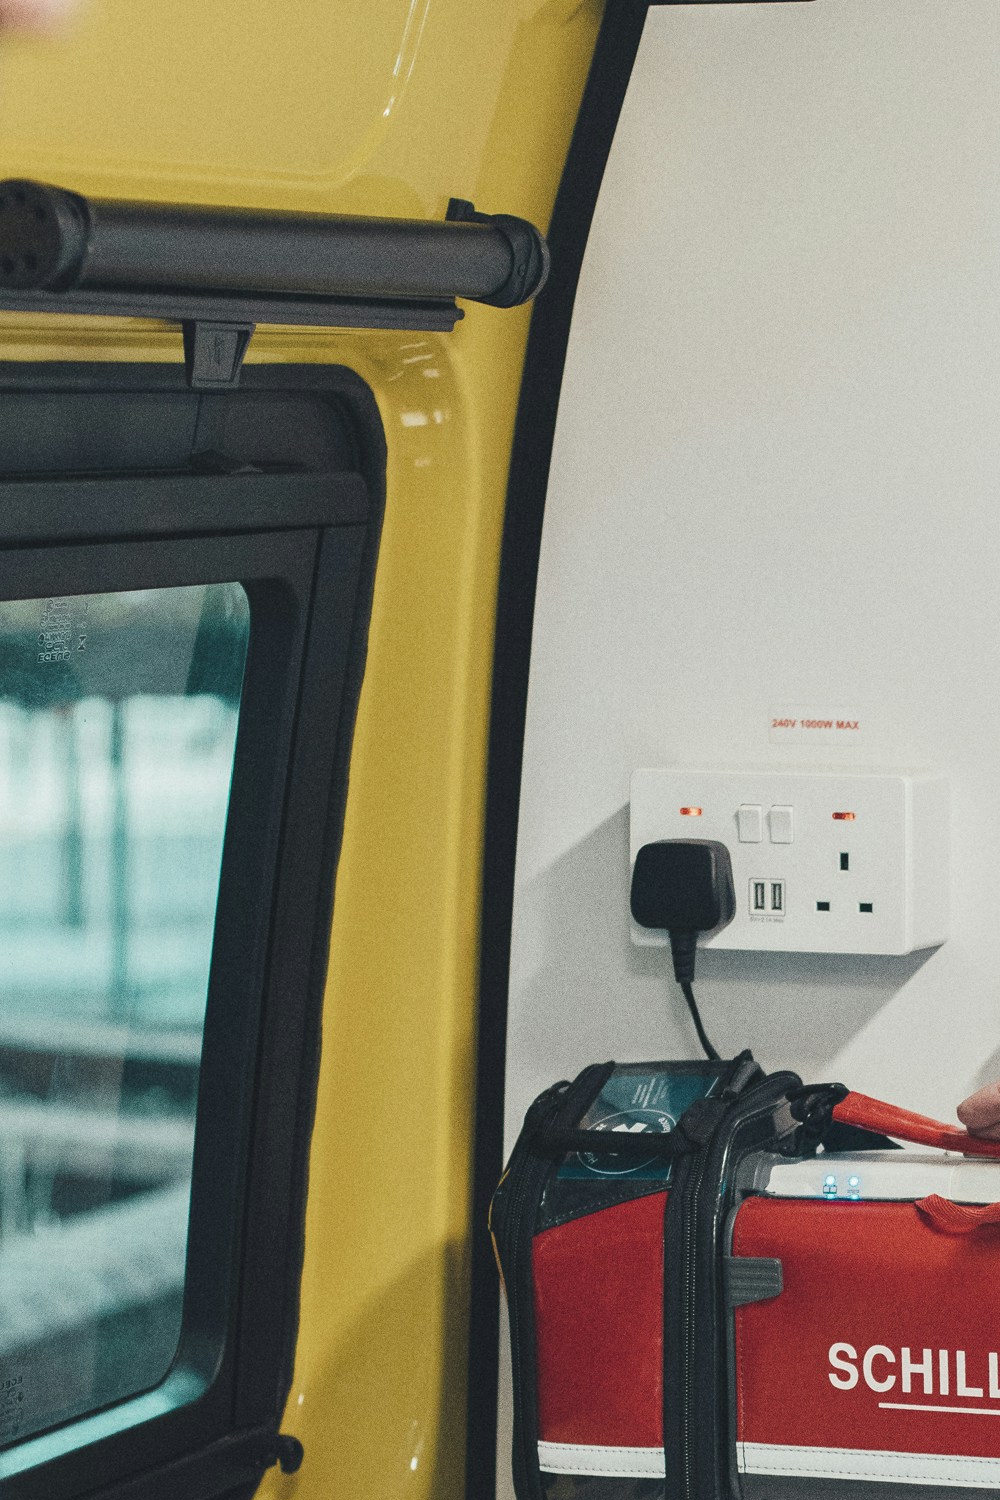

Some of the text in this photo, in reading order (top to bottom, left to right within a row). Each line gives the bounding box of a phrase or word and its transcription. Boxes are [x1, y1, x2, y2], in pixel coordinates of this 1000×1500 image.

[772, 718, 859, 729] 240V 1000W MAX
